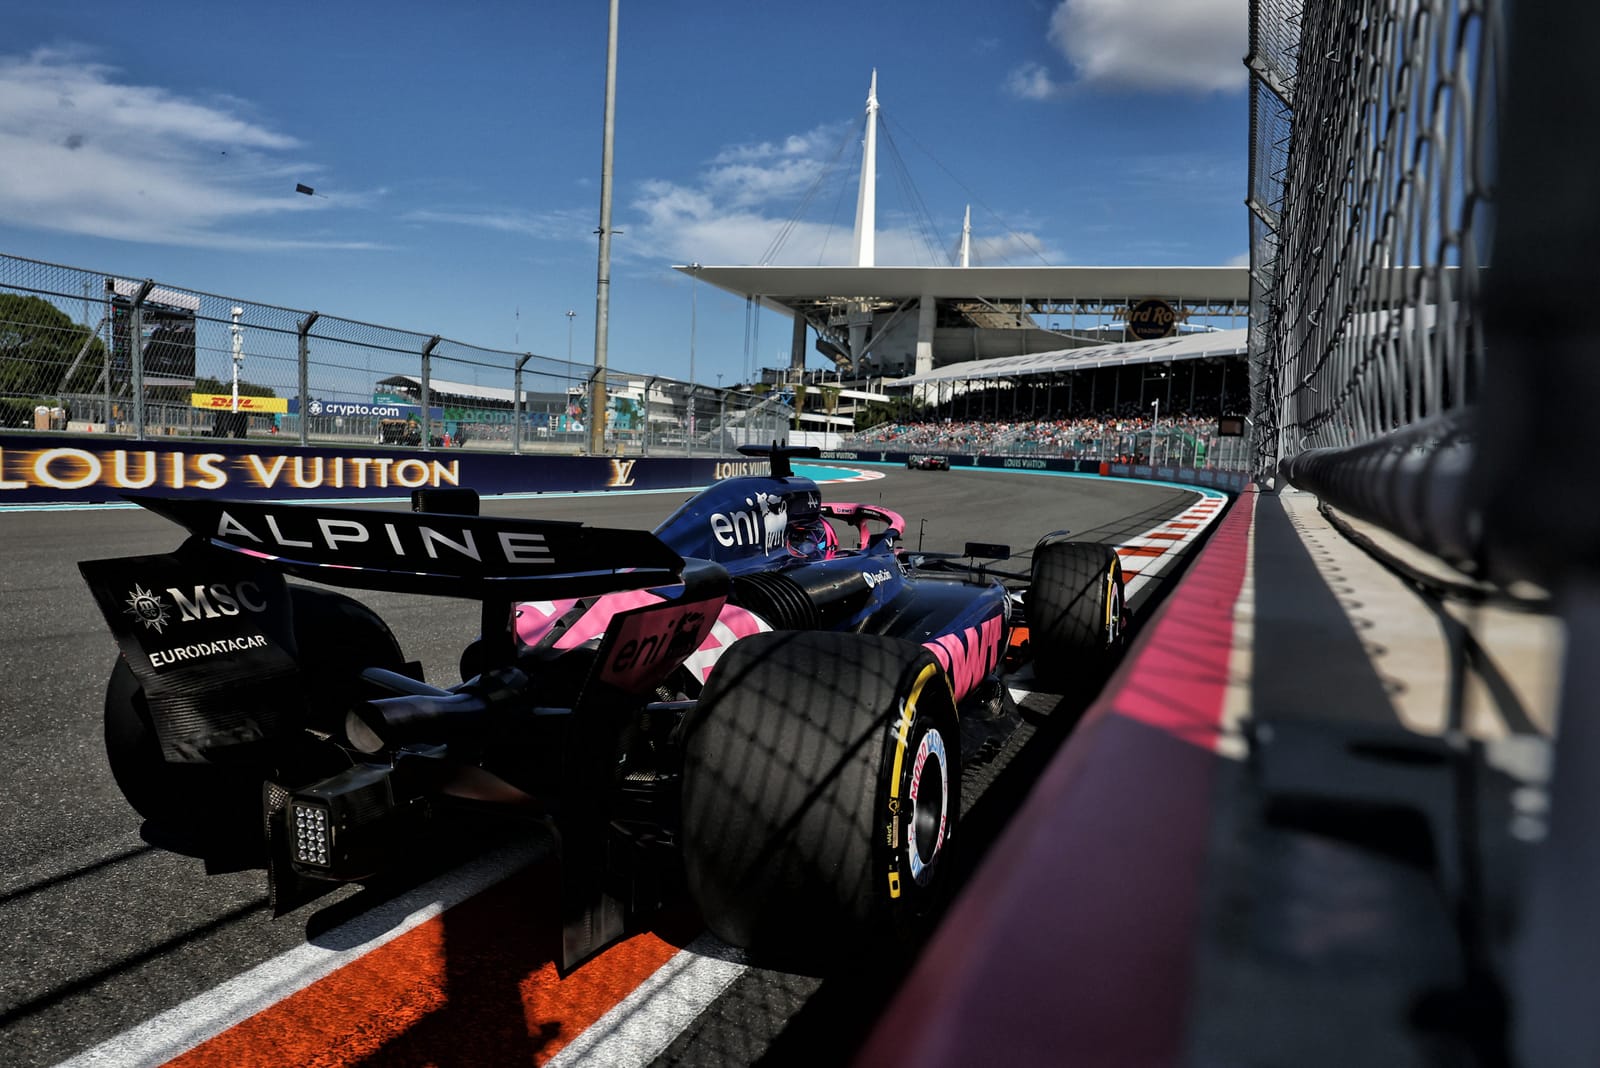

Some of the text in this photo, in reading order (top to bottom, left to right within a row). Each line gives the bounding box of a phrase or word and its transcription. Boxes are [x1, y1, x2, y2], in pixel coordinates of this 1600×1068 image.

[326, 402, 400, 417] crypto.com
[0, 446, 459, 490] LOUIS VUITTON
[715, 461, 748, 480] LOUIS
[217, 509, 556, 565] ALPINE
[710, 497, 760, 548] eni
[166, 581, 268, 622] MSC
[149, 635, 268, 668] EURODATACAR
[612, 620, 675, 673] eni
